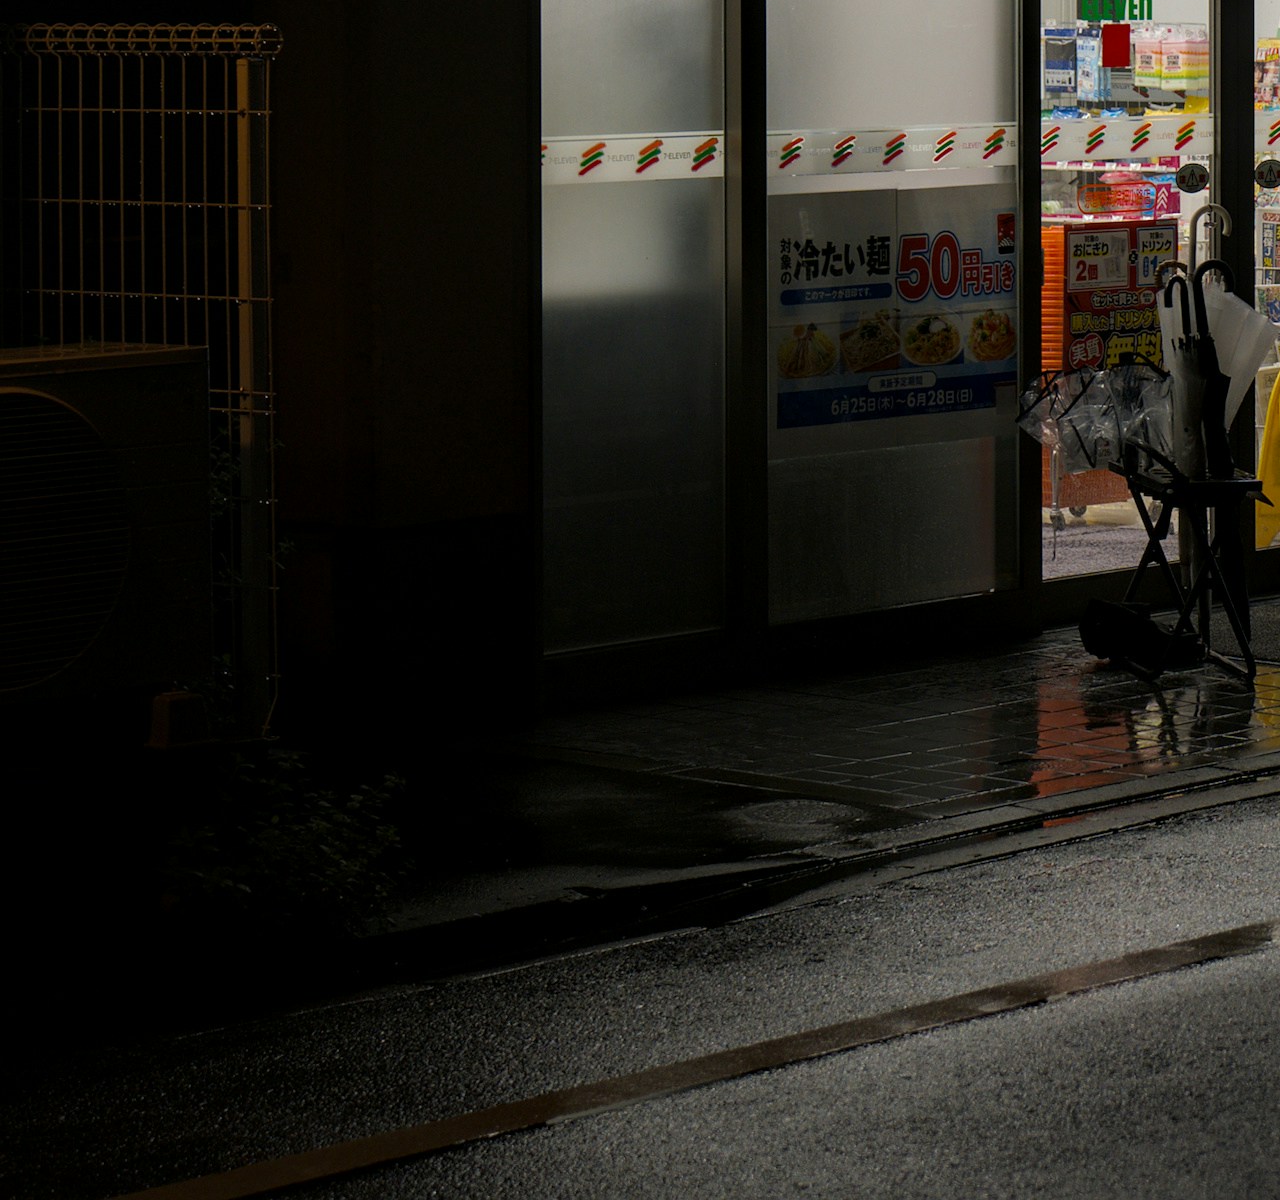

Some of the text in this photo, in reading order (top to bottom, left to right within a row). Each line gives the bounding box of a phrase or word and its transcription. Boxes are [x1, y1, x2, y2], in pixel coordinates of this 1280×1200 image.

[793, 235, 889, 281] 冷たい麺
[1073, 243, 1109, 257] おにぎり
[1141, 240, 1172, 252] ドリンク
[780, 237, 792, 285] 対象の
[897, 230, 1016, 302] 50円引き
[1076, 260, 1098, 281] 2個
[1072, 336, 1101, 365] 実質
